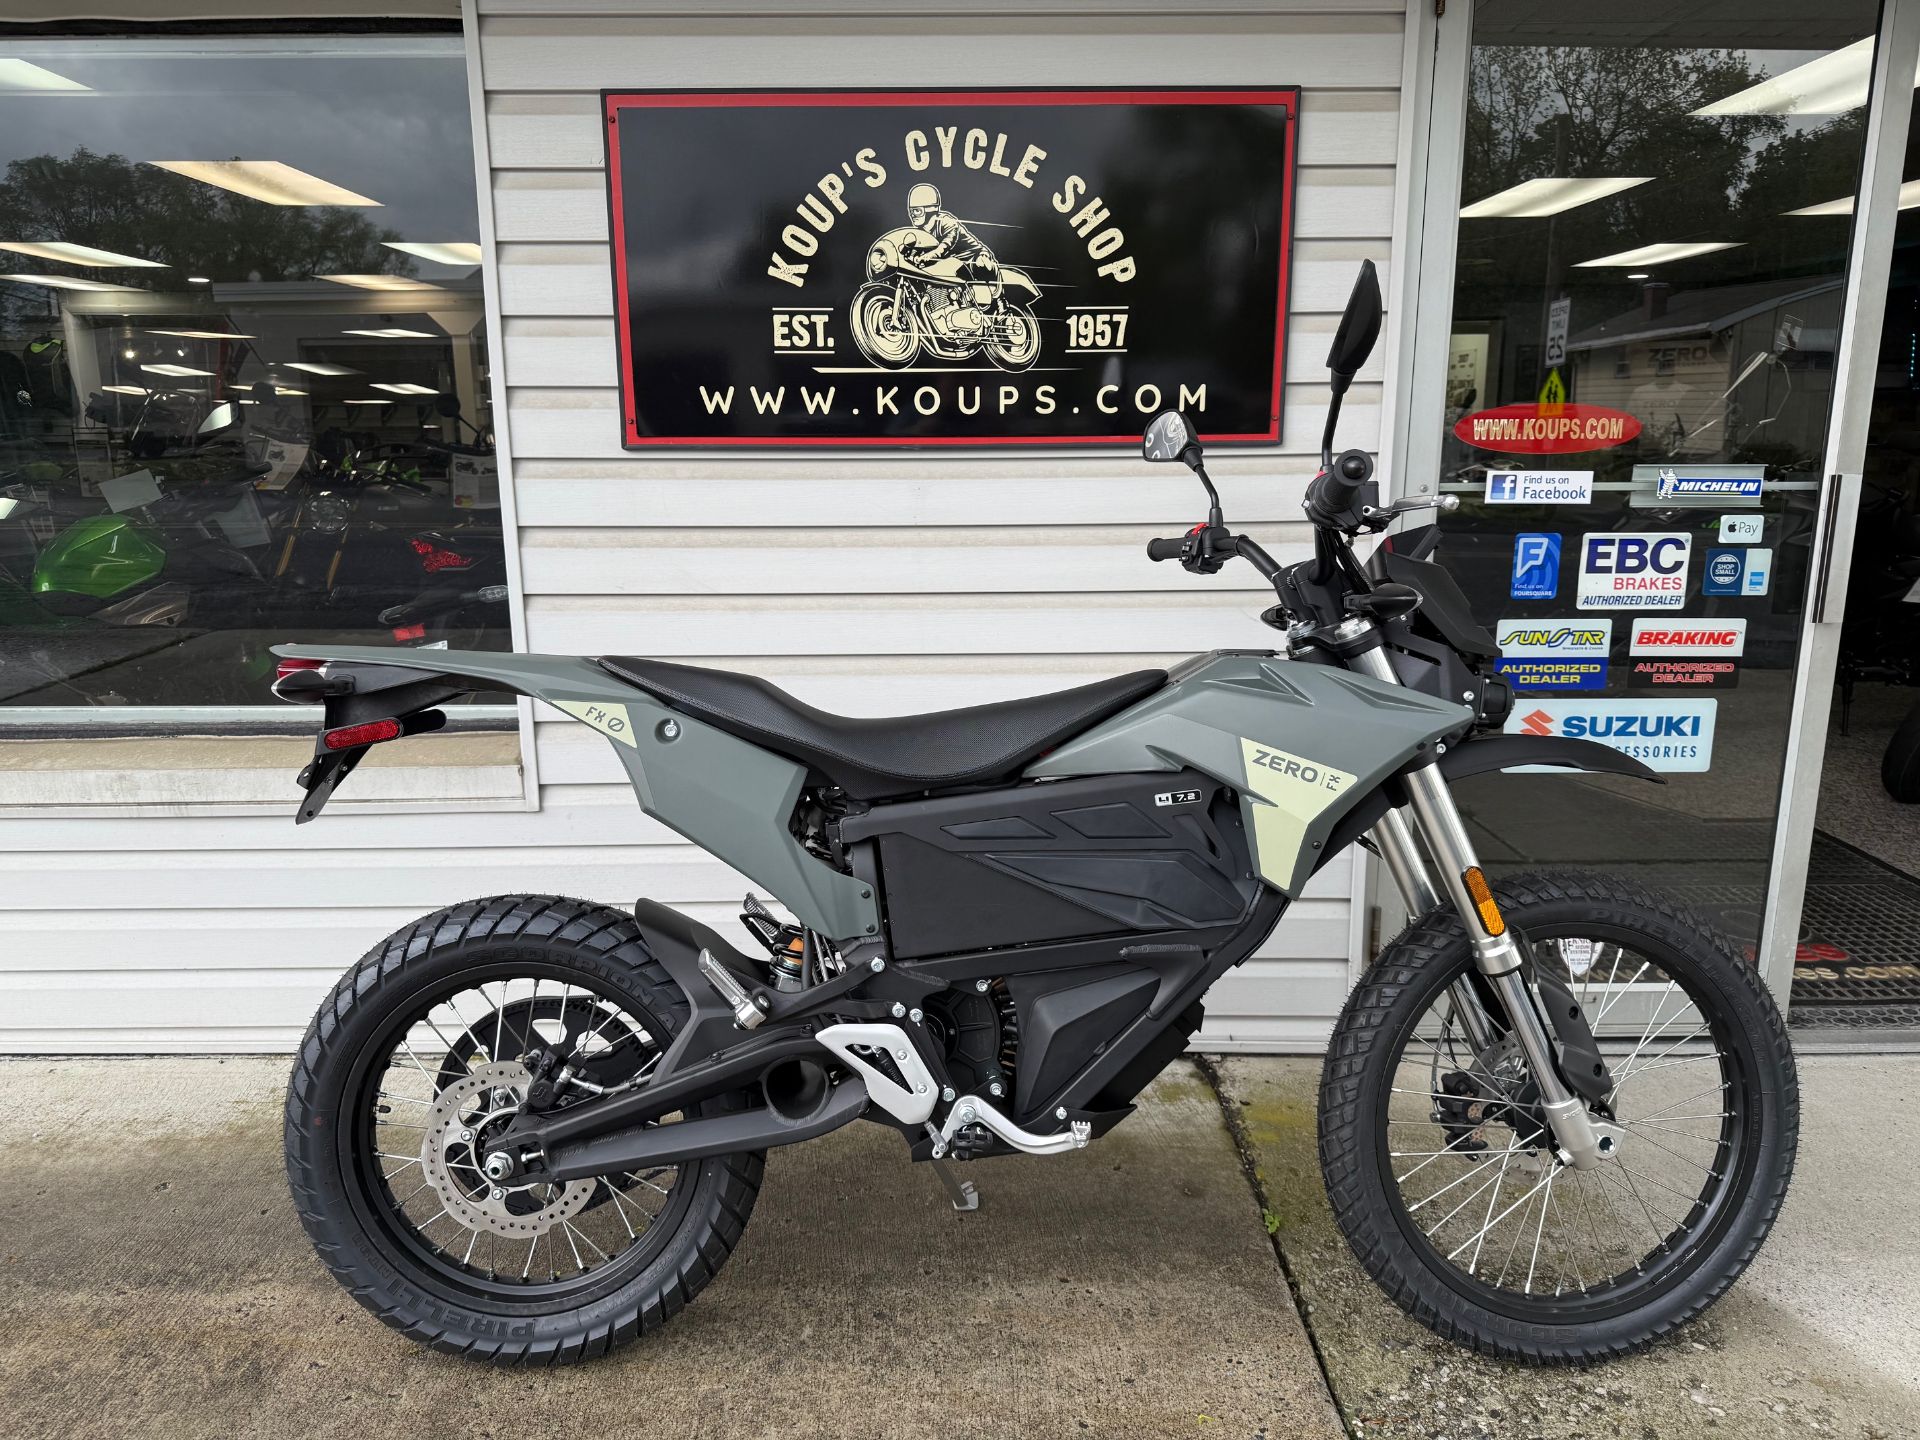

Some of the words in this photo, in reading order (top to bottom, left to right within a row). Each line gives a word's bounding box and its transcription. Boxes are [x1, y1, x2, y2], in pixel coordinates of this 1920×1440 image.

[767, 147, 887, 287] KOUP'S
[904, 126, 1047, 189] CYCLE
[1052, 174, 1137, 284] SHOP
[772, 312, 834, 348] EST.
[1066, 312, 1128, 348] 1957
[699, 383, 1208, 416] WWW.KOUPS.COM
[1473, 417, 1624, 441] WWW.KOUPS.COM
[1523, 475, 1543, 485] Find
[1545, 476, 1556, 485] us
[1557, 477, 1570, 485] on
[1678, 481, 1760, 492] MICHELIN
[1522, 485, 1587, 500] Facebook
[1738, 521, 1759, 537] Pay
[1584, 537, 1687, 575] EBC
[1612, 576, 1683, 591] BRAKES
[1582, 594, 1642, 607] AUTHORIZED
[1644, 594, 1682, 607] DEALER
[1636, 630, 1738, 647] BRAKING
[1500, 664, 1602, 674] AUTHORIZED
[1633, 662, 1735, 673] AUTHORIZED
[1519, 675, 1581, 684] DEALER
[1652, 673, 1714, 683] DEALER
[585, 705, 607, 723] FX
[1561, 715, 1701, 738] SUZUKI
[1615, 744, 1698, 758] ESSORIES
[1252, 748, 1319, 783] ZERO
[1325, 773, 1341, 792] FX
[1176, 792, 1196, 802] 7.2
[386, 1278, 536, 1340] PIRELLI
